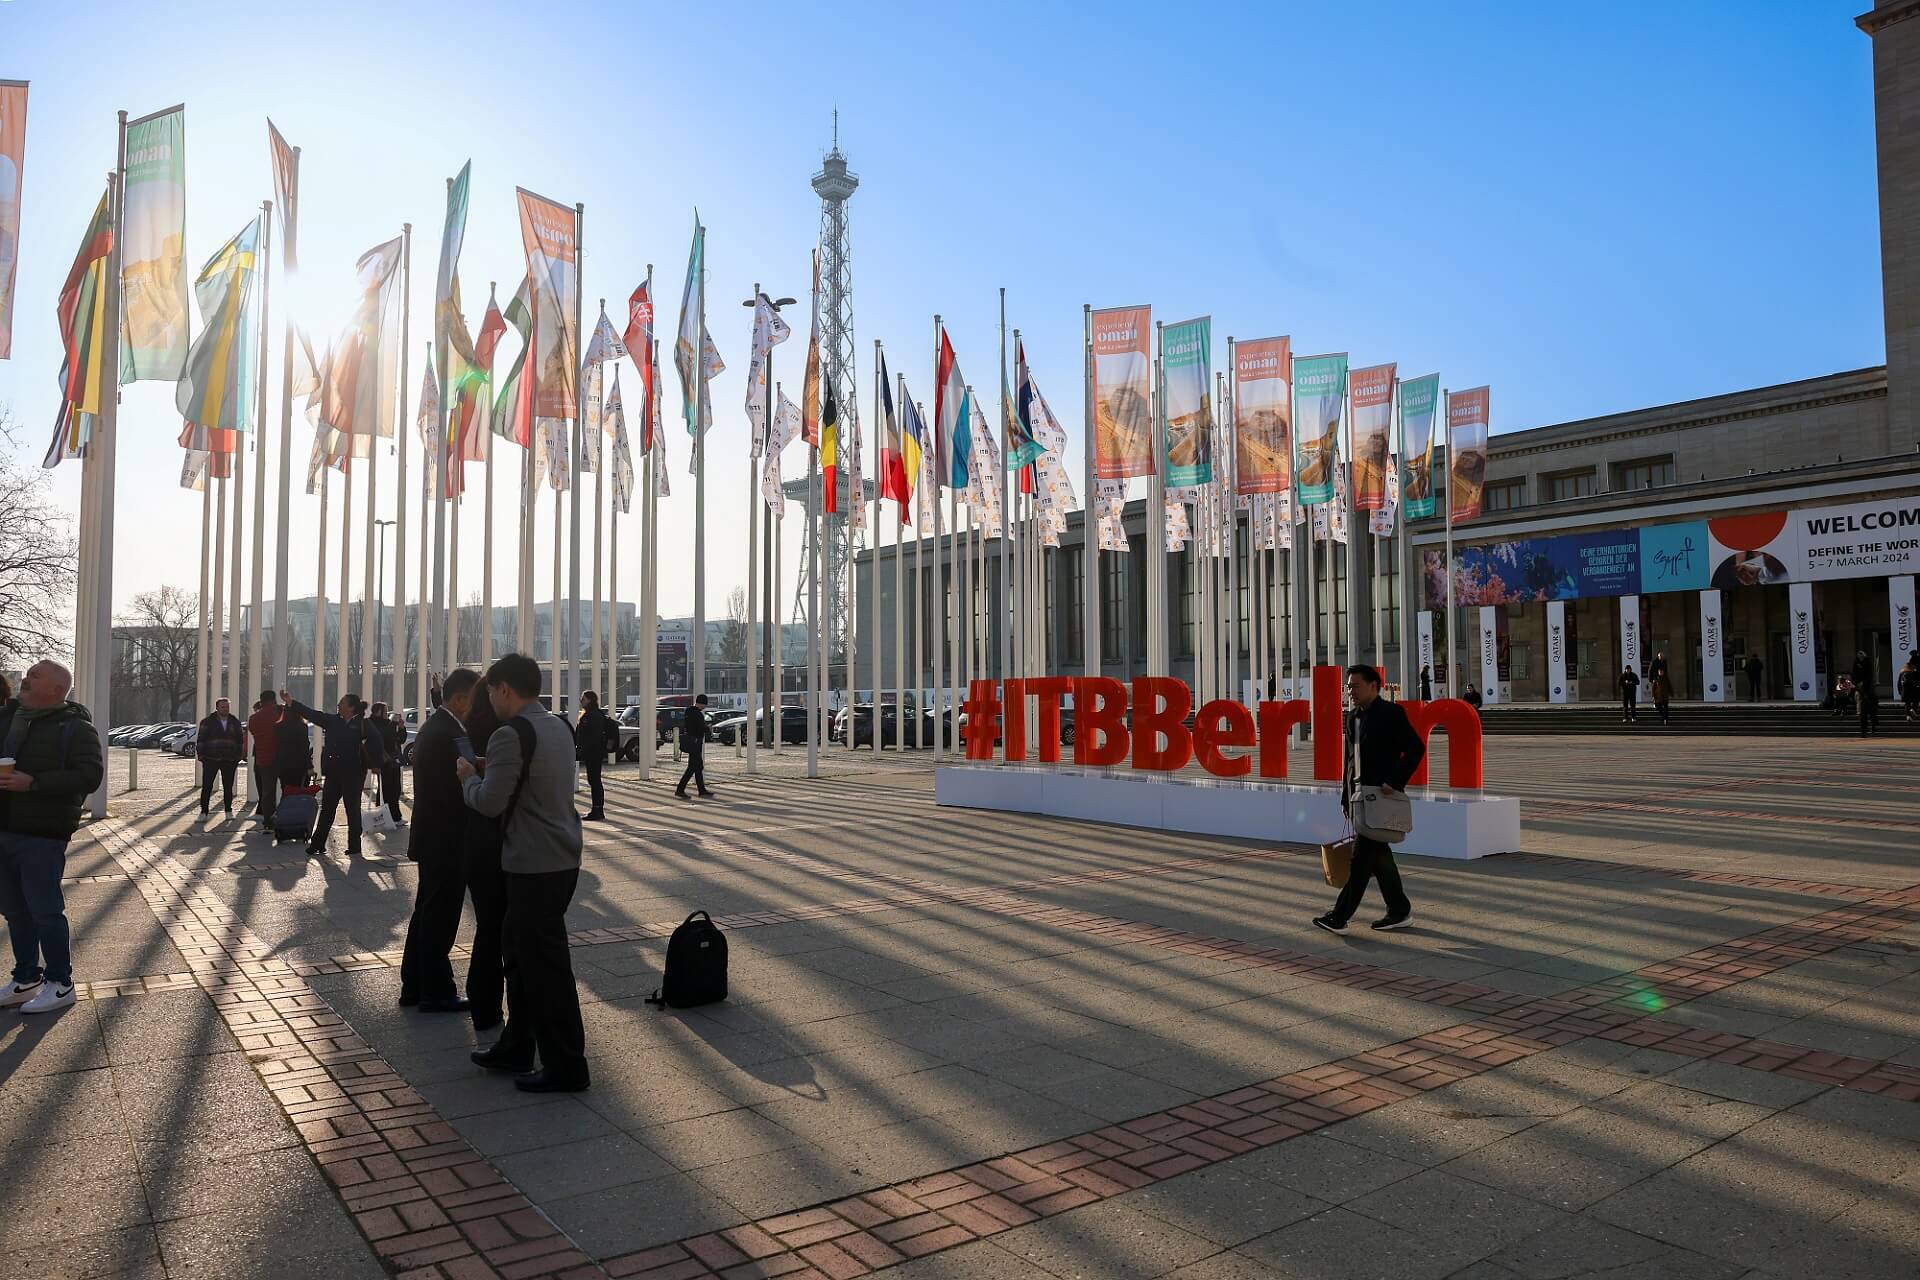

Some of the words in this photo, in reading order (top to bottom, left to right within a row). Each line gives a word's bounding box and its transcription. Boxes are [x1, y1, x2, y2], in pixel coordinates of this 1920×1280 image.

[1097, 328, 1137, 342] oman
[1168, 341, 1201, 355] oman
[1240, 357, 1280, 370] oman
[1299, 374, 1336, 385] oman
[1354, 384, 1388, 397] oman
[1405, 393, 1432, 407] oman
[1451, 405, 1481, 417] oman
[1808, 545, 1854, 558] DEFINE
[1857, 542, 1882, 554] THE
[1886, 539, 1920, 551] WOR
[1809, 560, 1815, 570] 5
[1828, 559, 1833, 568] 7
[1836, 555, 1879, 568] MARCH
[1882, 552, 1909, 564] 2024
[1708, 628, 1717, 657] QATAR
[1797, 623, 1807, 655] QATAR
[1898, 618, 1910, 651] QATAR
[1553, 635, 1561, 663] QATAR
[1627, 632, 1635, 660] QATAR
[962, 665, 1483, 789] #ITBBerln
